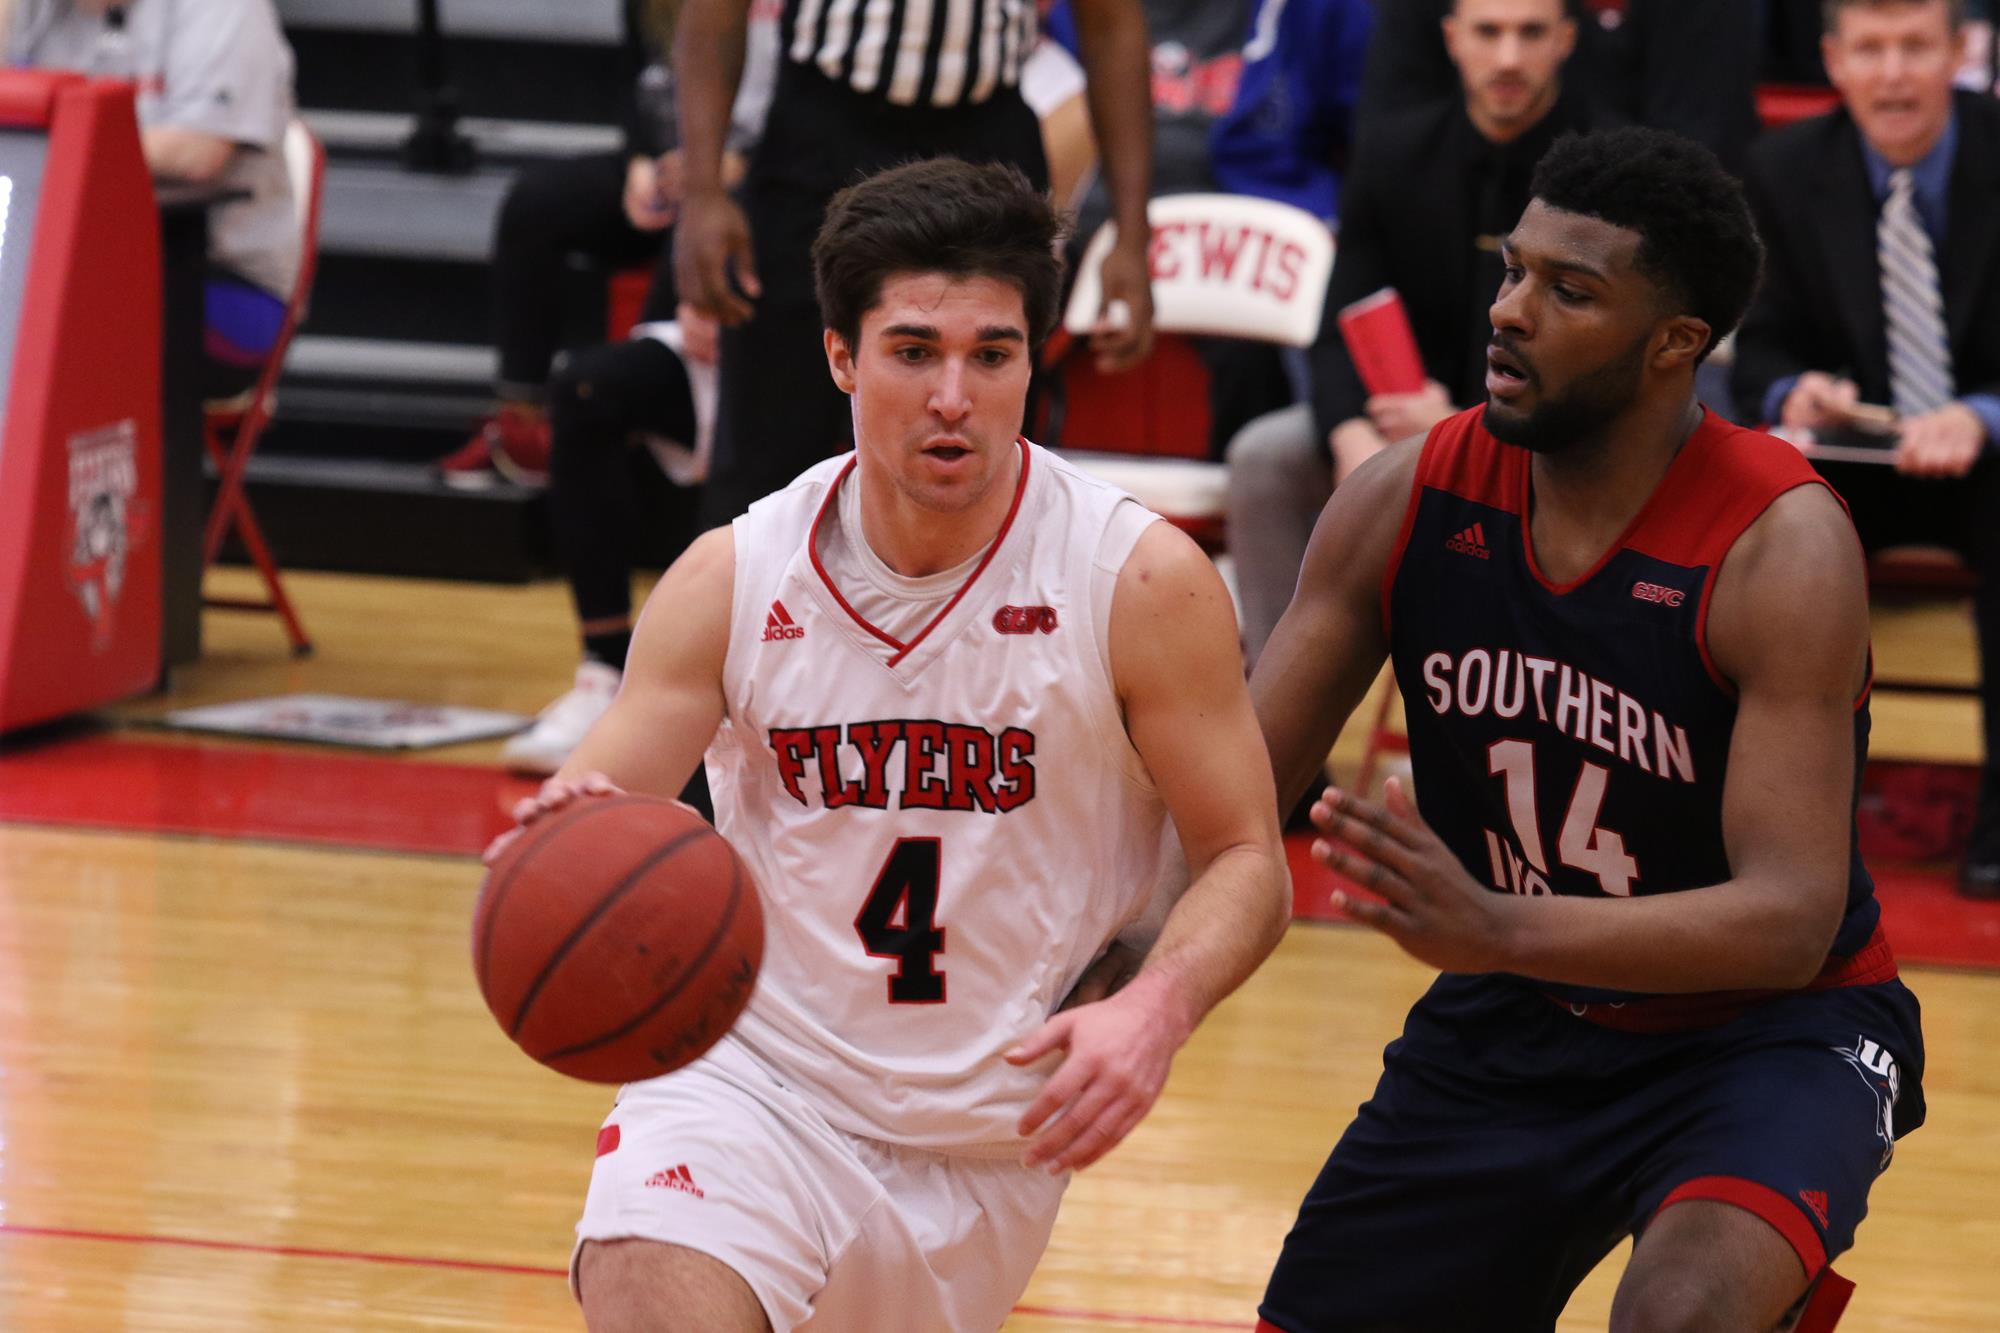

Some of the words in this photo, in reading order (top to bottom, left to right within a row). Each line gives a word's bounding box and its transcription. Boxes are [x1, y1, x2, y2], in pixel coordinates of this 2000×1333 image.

[1149, 221, 1308, 304] EWIS
[1445, 538, 1491, 560] adidas
[1631, 581, 1687, 607] GLVC
[1422, 648, 1697, 783] SOUTHERN
[768, 719, 1036, 814] FLYERS
[1486, 736, 1642, 897] 14
[853, 836, 947, 1004] 4
